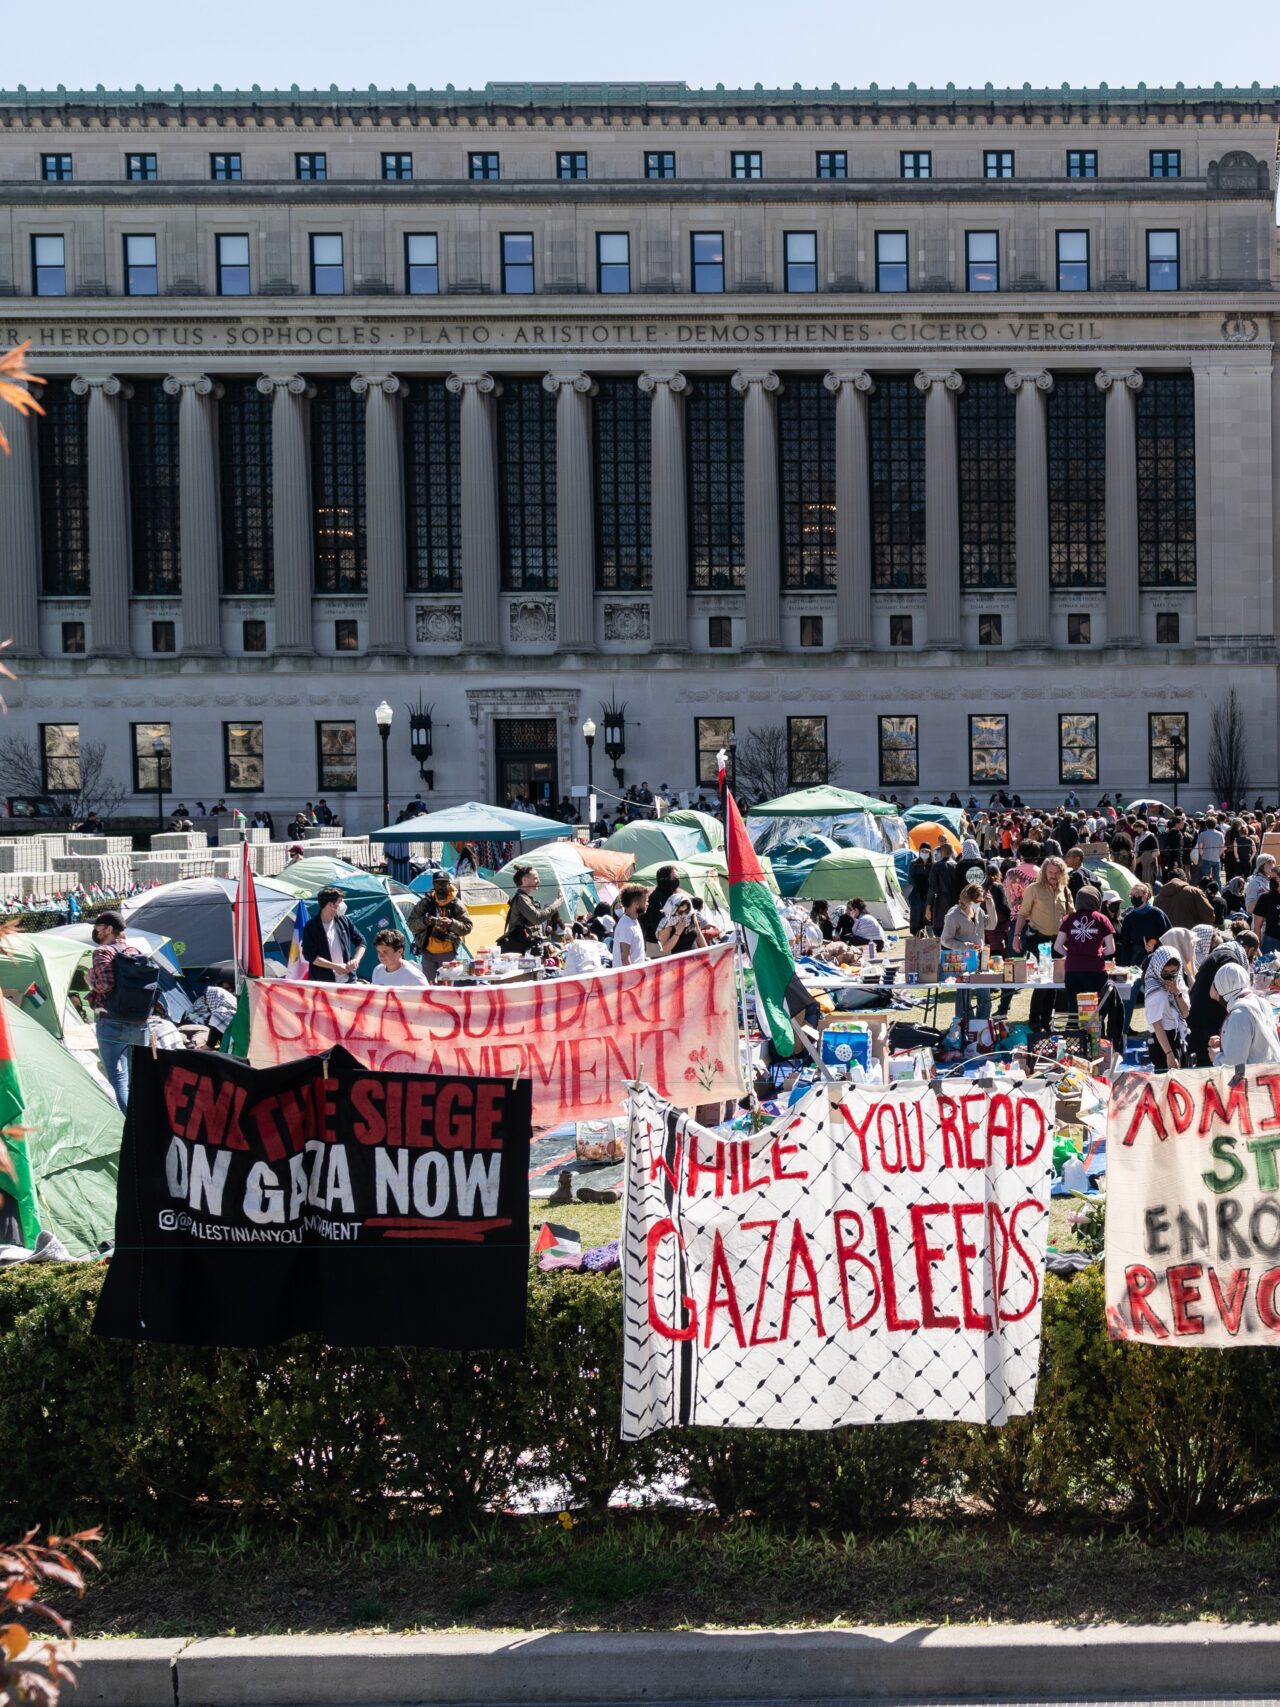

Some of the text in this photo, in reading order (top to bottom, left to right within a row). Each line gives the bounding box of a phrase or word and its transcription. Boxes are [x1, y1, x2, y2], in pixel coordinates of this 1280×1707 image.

[0, 321, 1102, 346] R HERODOTUS SOPHOCLES PLATO ARISTOTLE DEMOSTHENES CICERO VERGIL
[265, 981, 421, 1042] GAZA
[350, 1079, 506, 1149] SIEGE
[647, 1093, 1046, 1198] WHILE YOU READ
[166, 1136, 502, 1224] ON GAZA NOW
[647, 1199, 1045, 1350] GAZA BLEEDS
